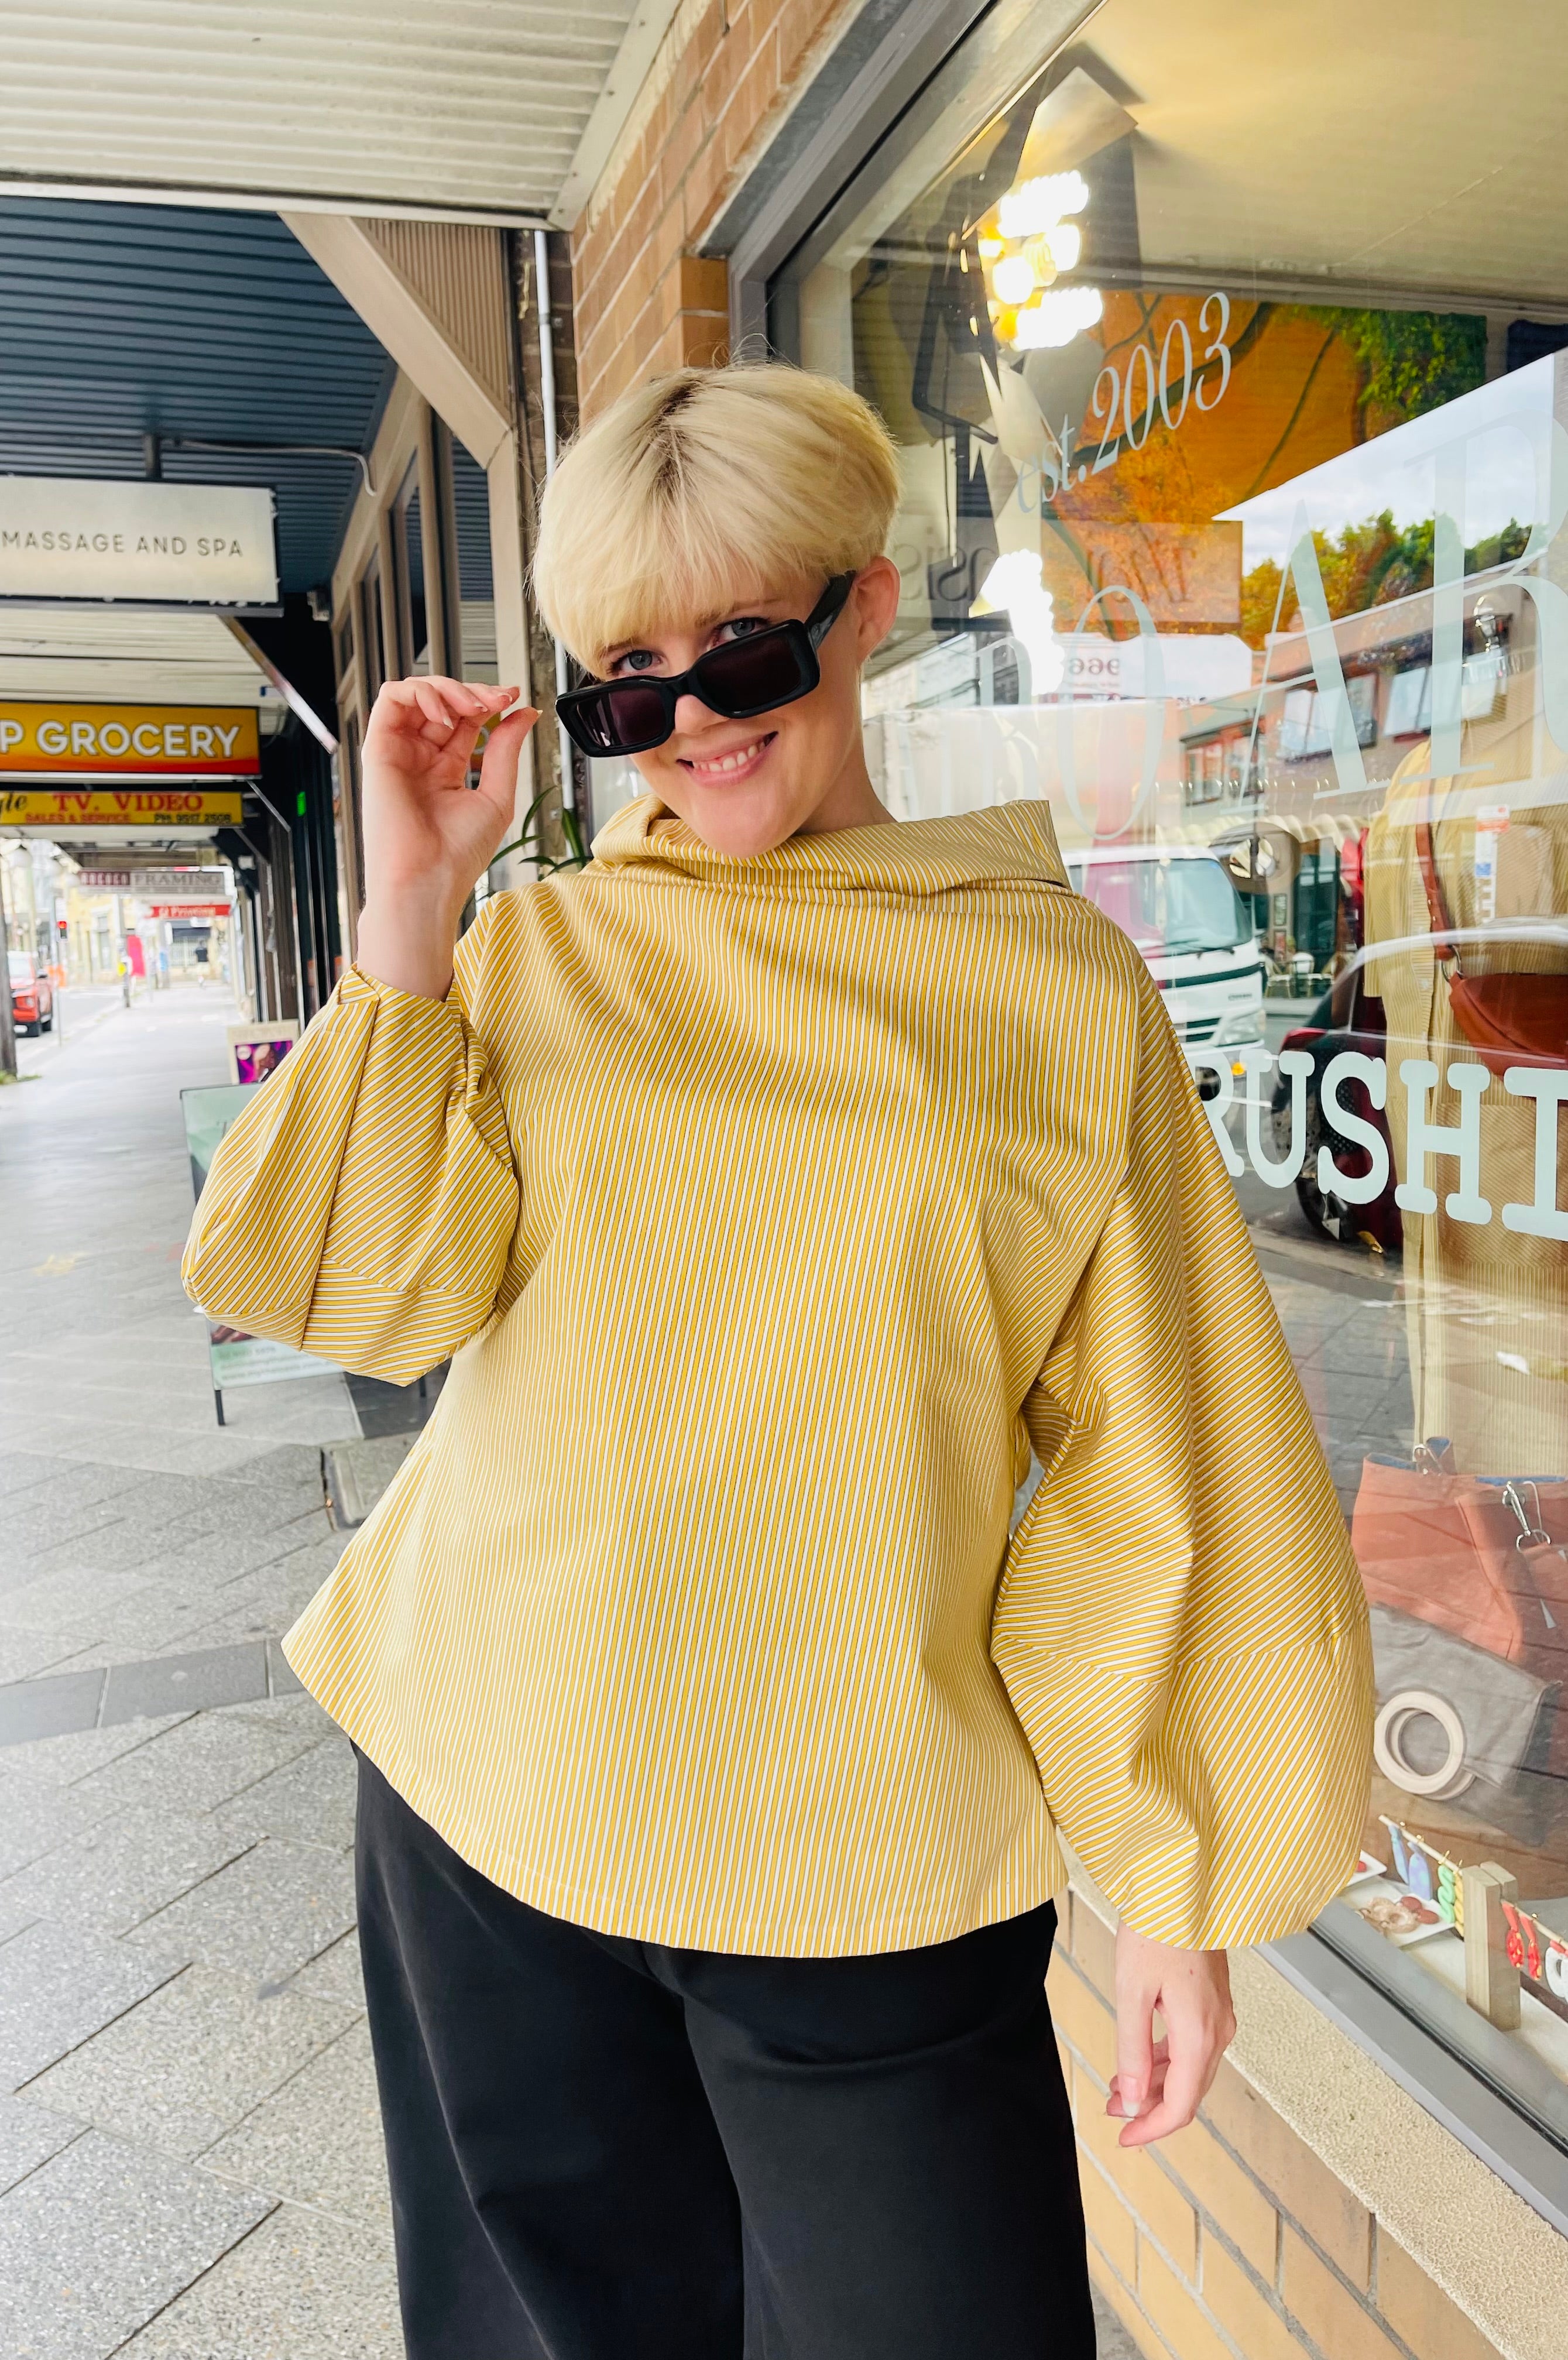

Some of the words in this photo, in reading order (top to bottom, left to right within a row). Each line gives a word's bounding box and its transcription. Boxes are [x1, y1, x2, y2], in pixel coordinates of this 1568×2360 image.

[2, 531, 124, 553] MASSAGE
[136, 536, 187, 555] AND
[197, 537, 243, 557] SPA
[36, 720, 239, 758] GROCERY
[112, 793, 204, 812] VIDEO
[135, 873, 221, 886] FRAMING
